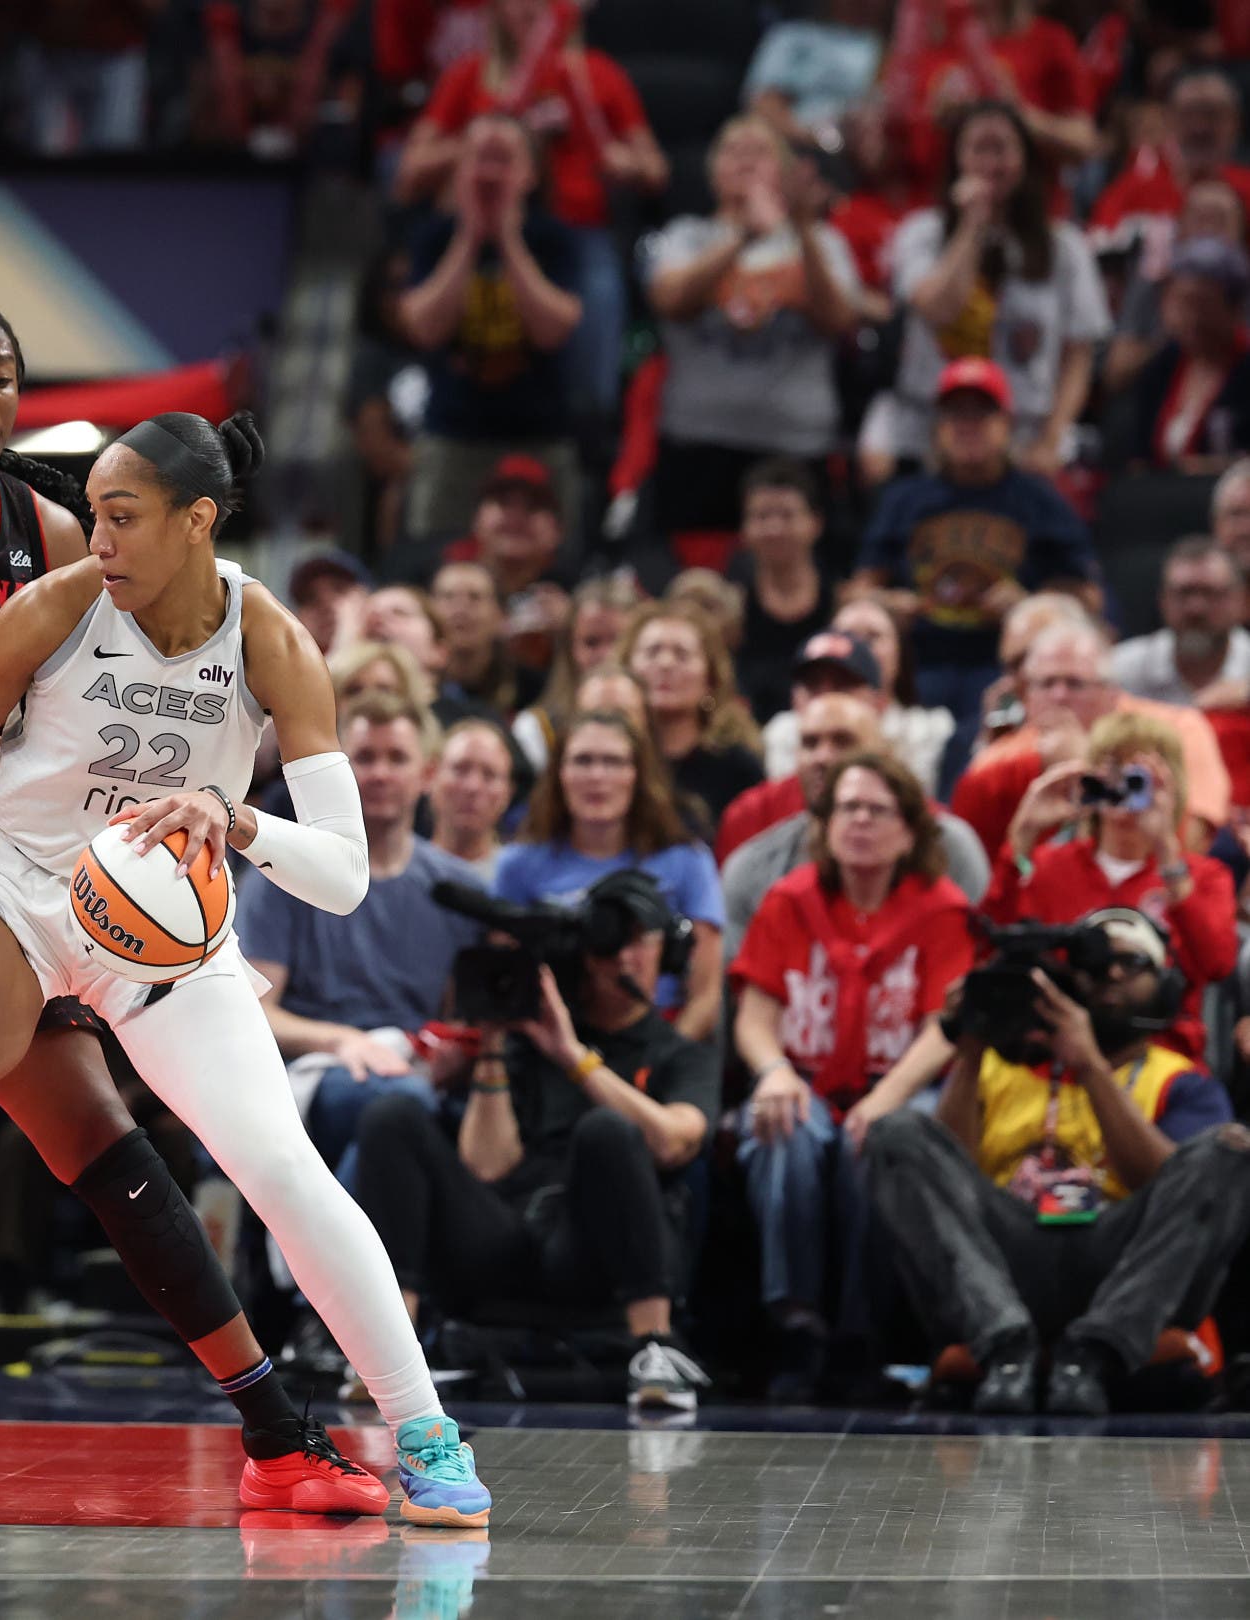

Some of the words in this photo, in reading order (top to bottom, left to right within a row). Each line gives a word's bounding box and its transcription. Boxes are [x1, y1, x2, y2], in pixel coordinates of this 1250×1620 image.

[82, 672, 228, 725] ACES
[198, 664, 234, 687] ally
[88, 723, 191, 787] 22
[83, 785, 162, 816] rin
[72, 863, 146, 957] Wilson
